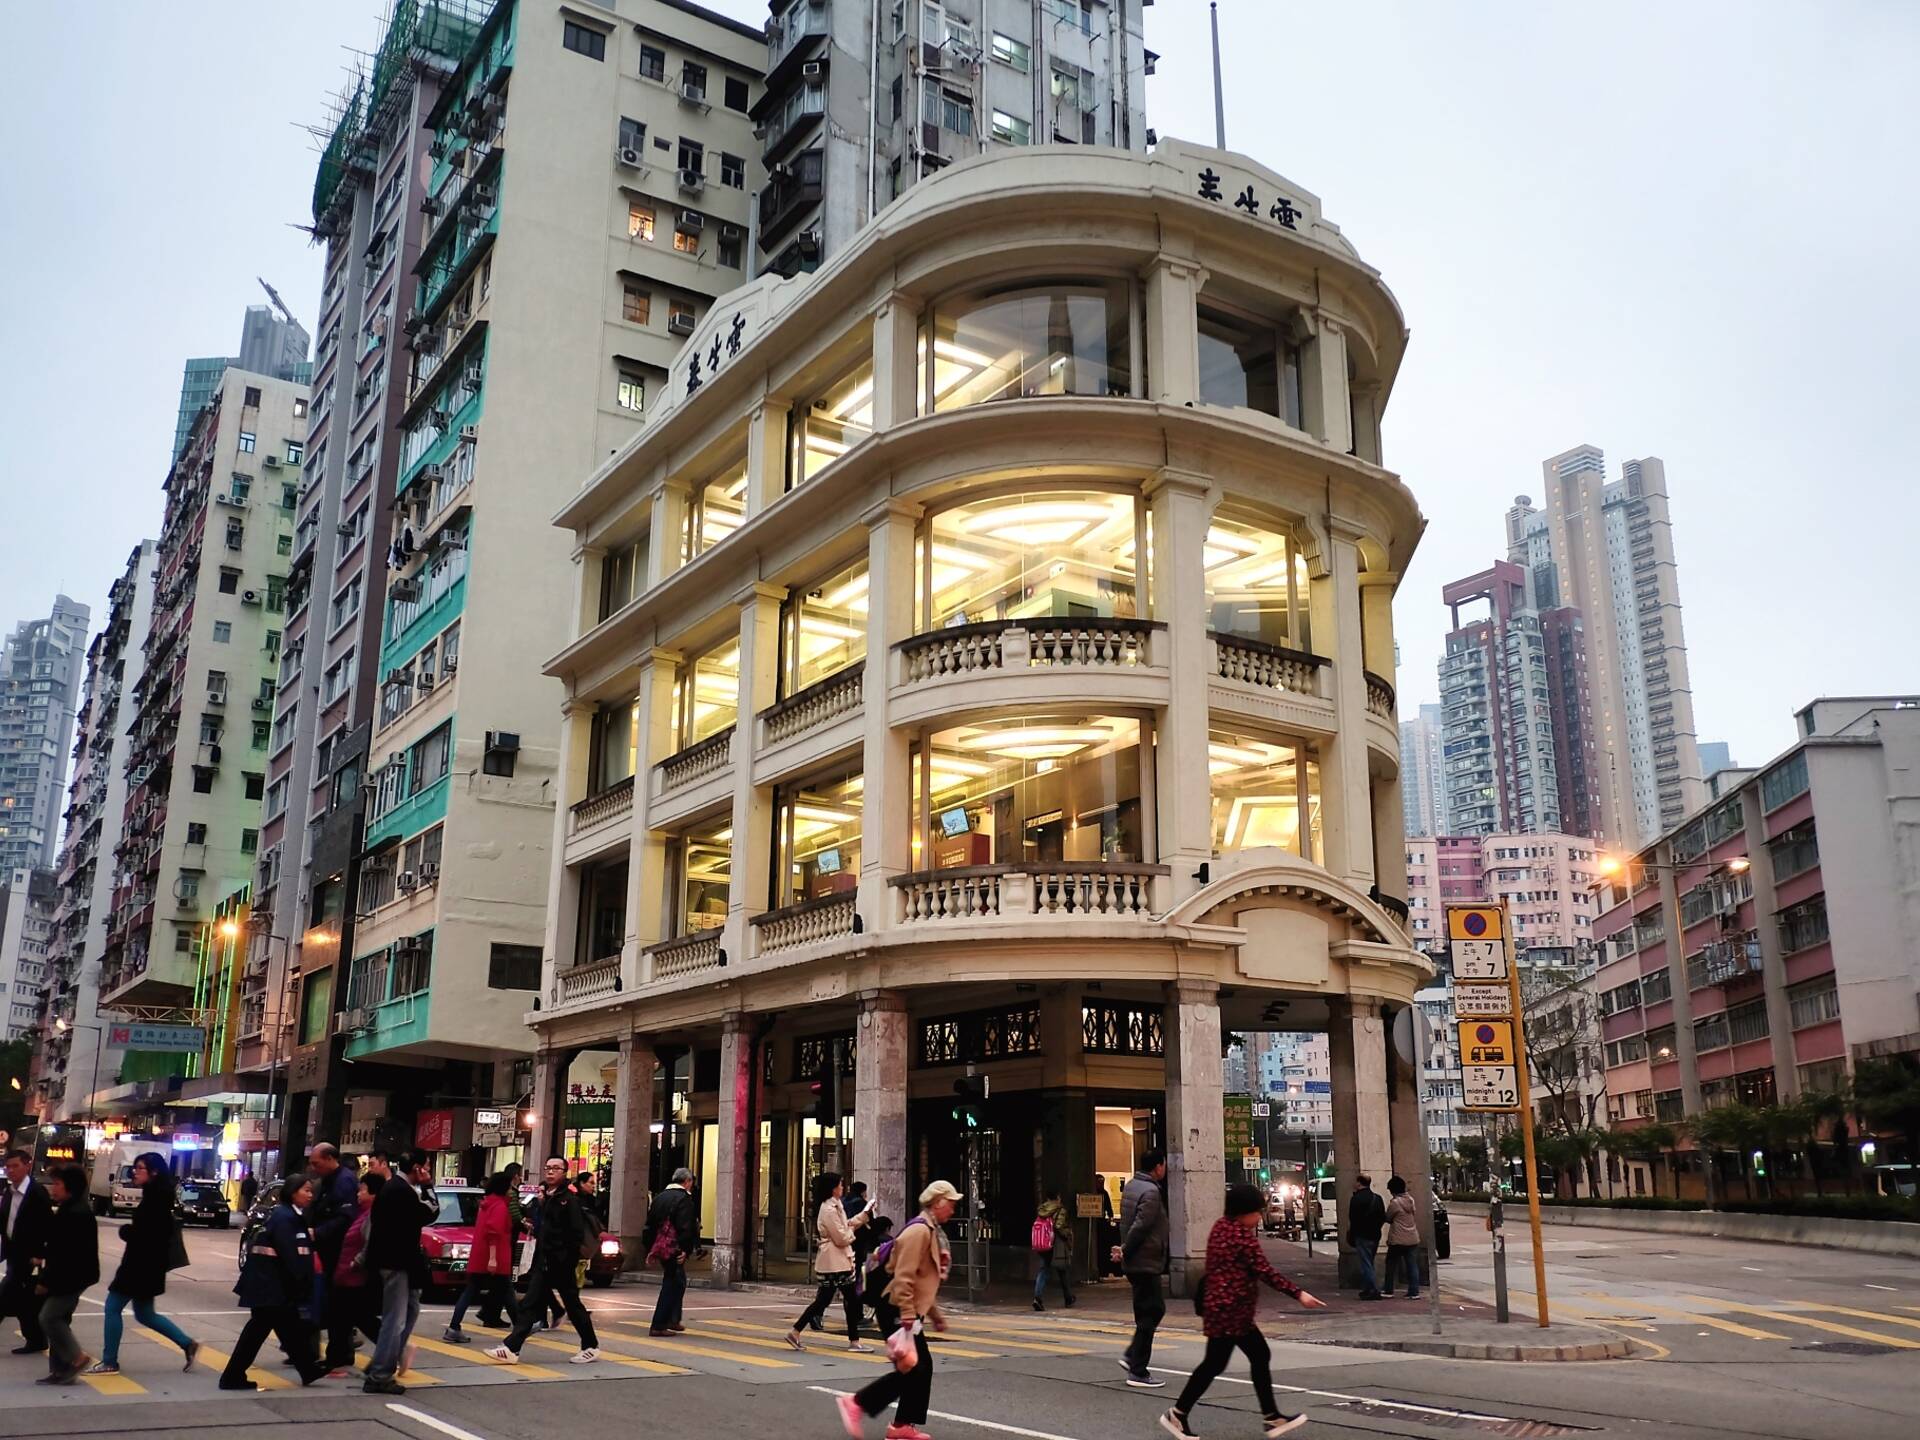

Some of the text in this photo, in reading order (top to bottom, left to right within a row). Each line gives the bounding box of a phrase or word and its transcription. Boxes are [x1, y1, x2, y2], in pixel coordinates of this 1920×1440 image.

[1462, 947, 1477, 956] 上午
[1485, 943, 1494, 956] 7
[1464, 968, 1479, 976] 下午
[1487, 963, 1496, 976] 7
[1471, 988, 1492, 996] Except
[1481, 994, 1507, 1002] Holidays
[1472, 1073, 1488, 1081] 上午
[1495, 1069, 1505, 1081] 7
[1466, 1088, 1514, 1103] midnight 12
